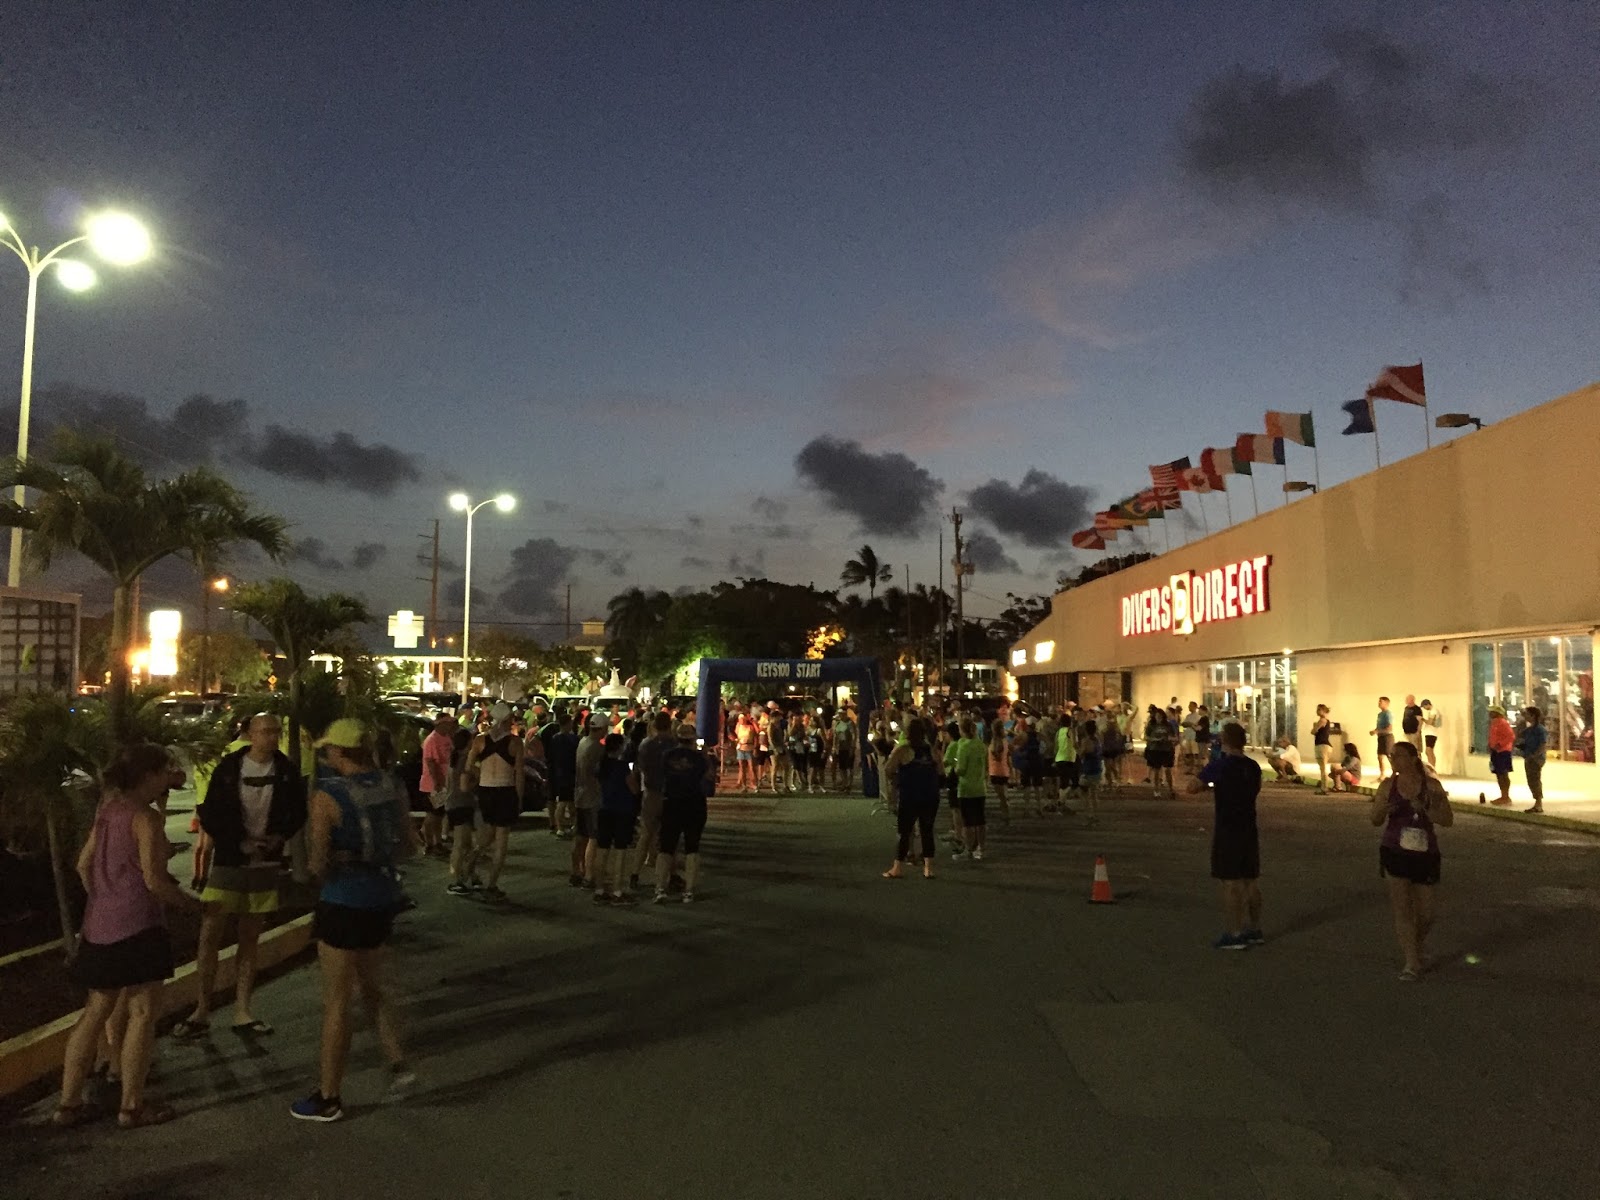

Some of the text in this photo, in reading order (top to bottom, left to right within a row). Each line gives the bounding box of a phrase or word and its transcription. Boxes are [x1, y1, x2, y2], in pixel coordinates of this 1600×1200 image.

[1122, 555, 1269, 637] DIVERS DIRECT
[756, 662, 822, 678] KEYS100 START
